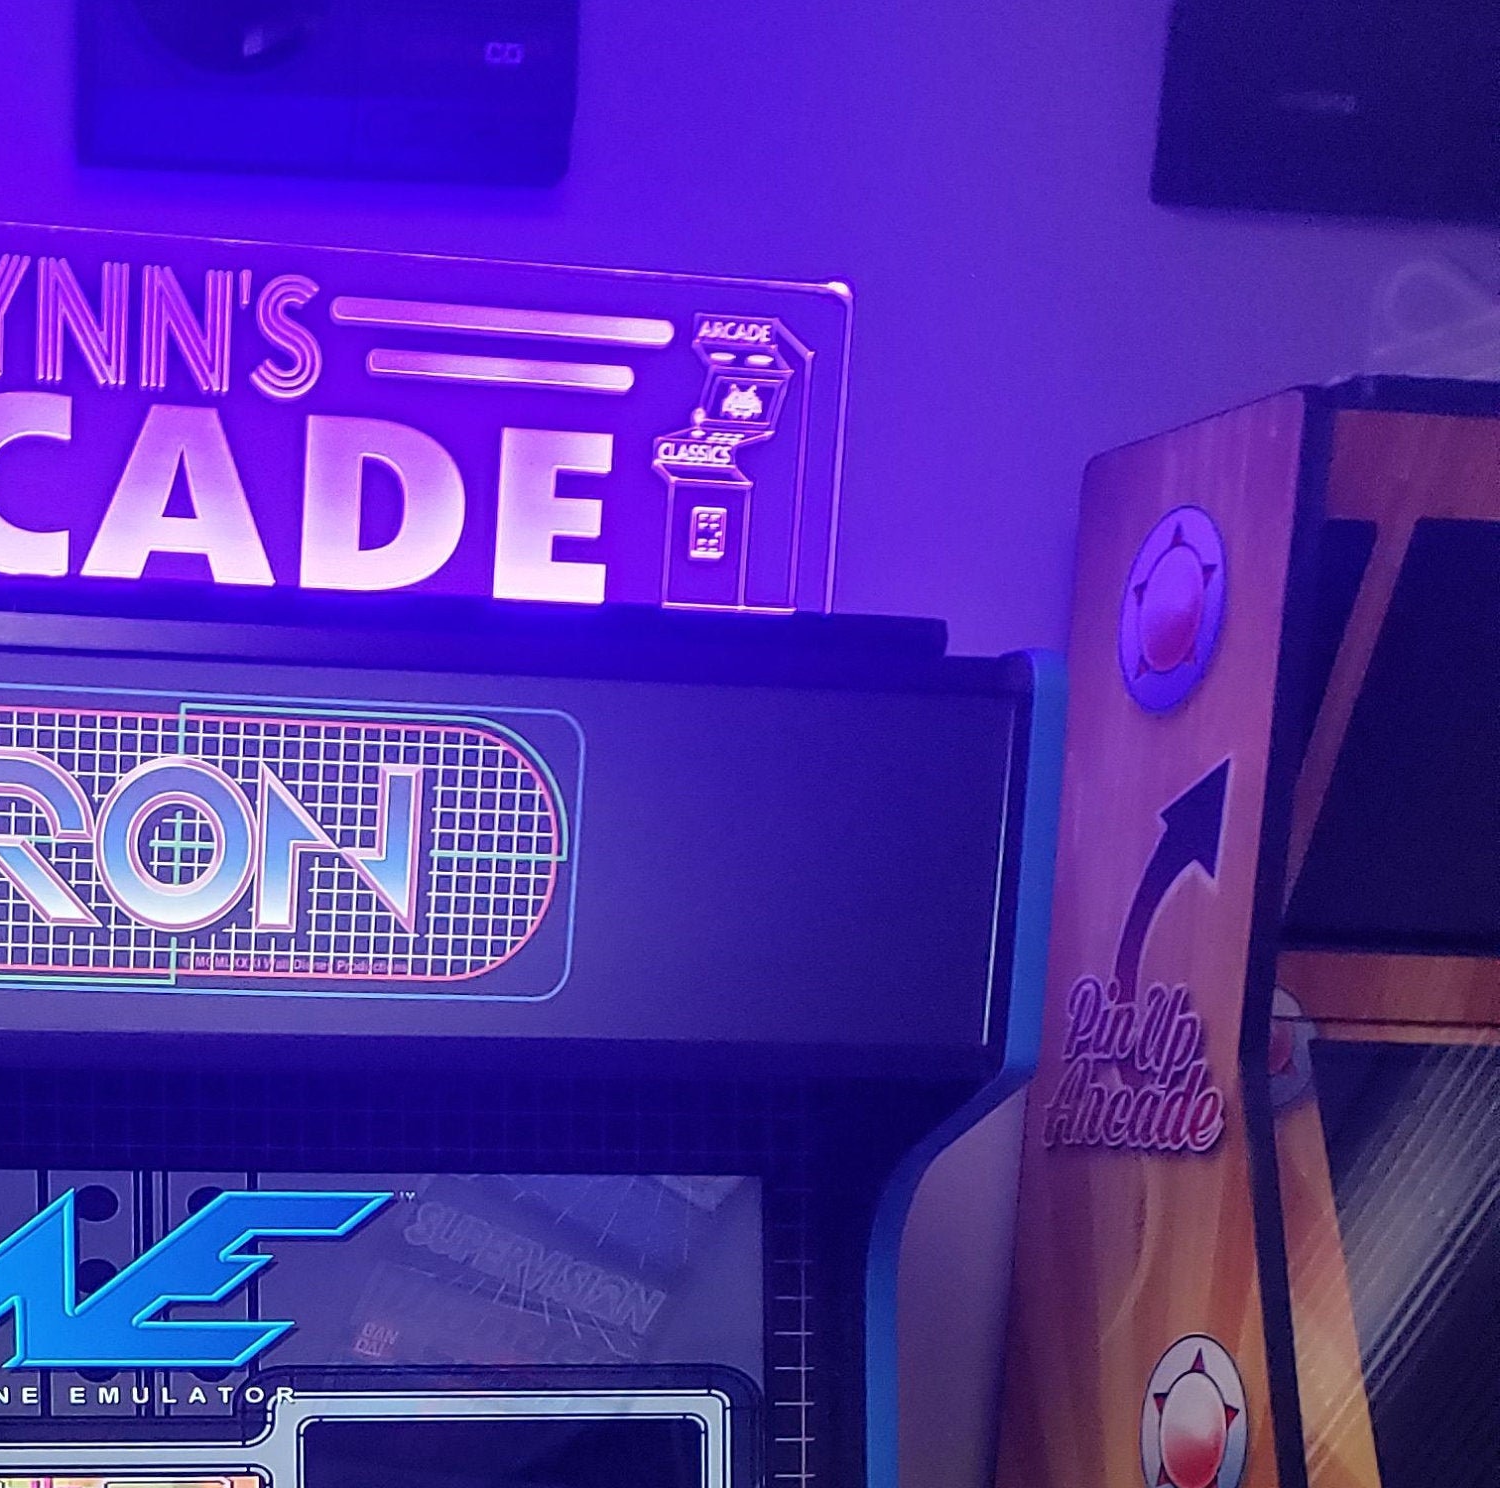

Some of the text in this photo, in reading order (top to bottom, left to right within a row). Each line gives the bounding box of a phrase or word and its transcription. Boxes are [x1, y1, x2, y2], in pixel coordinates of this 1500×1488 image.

[698, 320, 772, 343] ARCADE
[657, 442, 733, 464] CLASSICS
[1042, 1056, 1226, 1153] Arcade
[68, 1386, 297, 1406] EMULATOR
